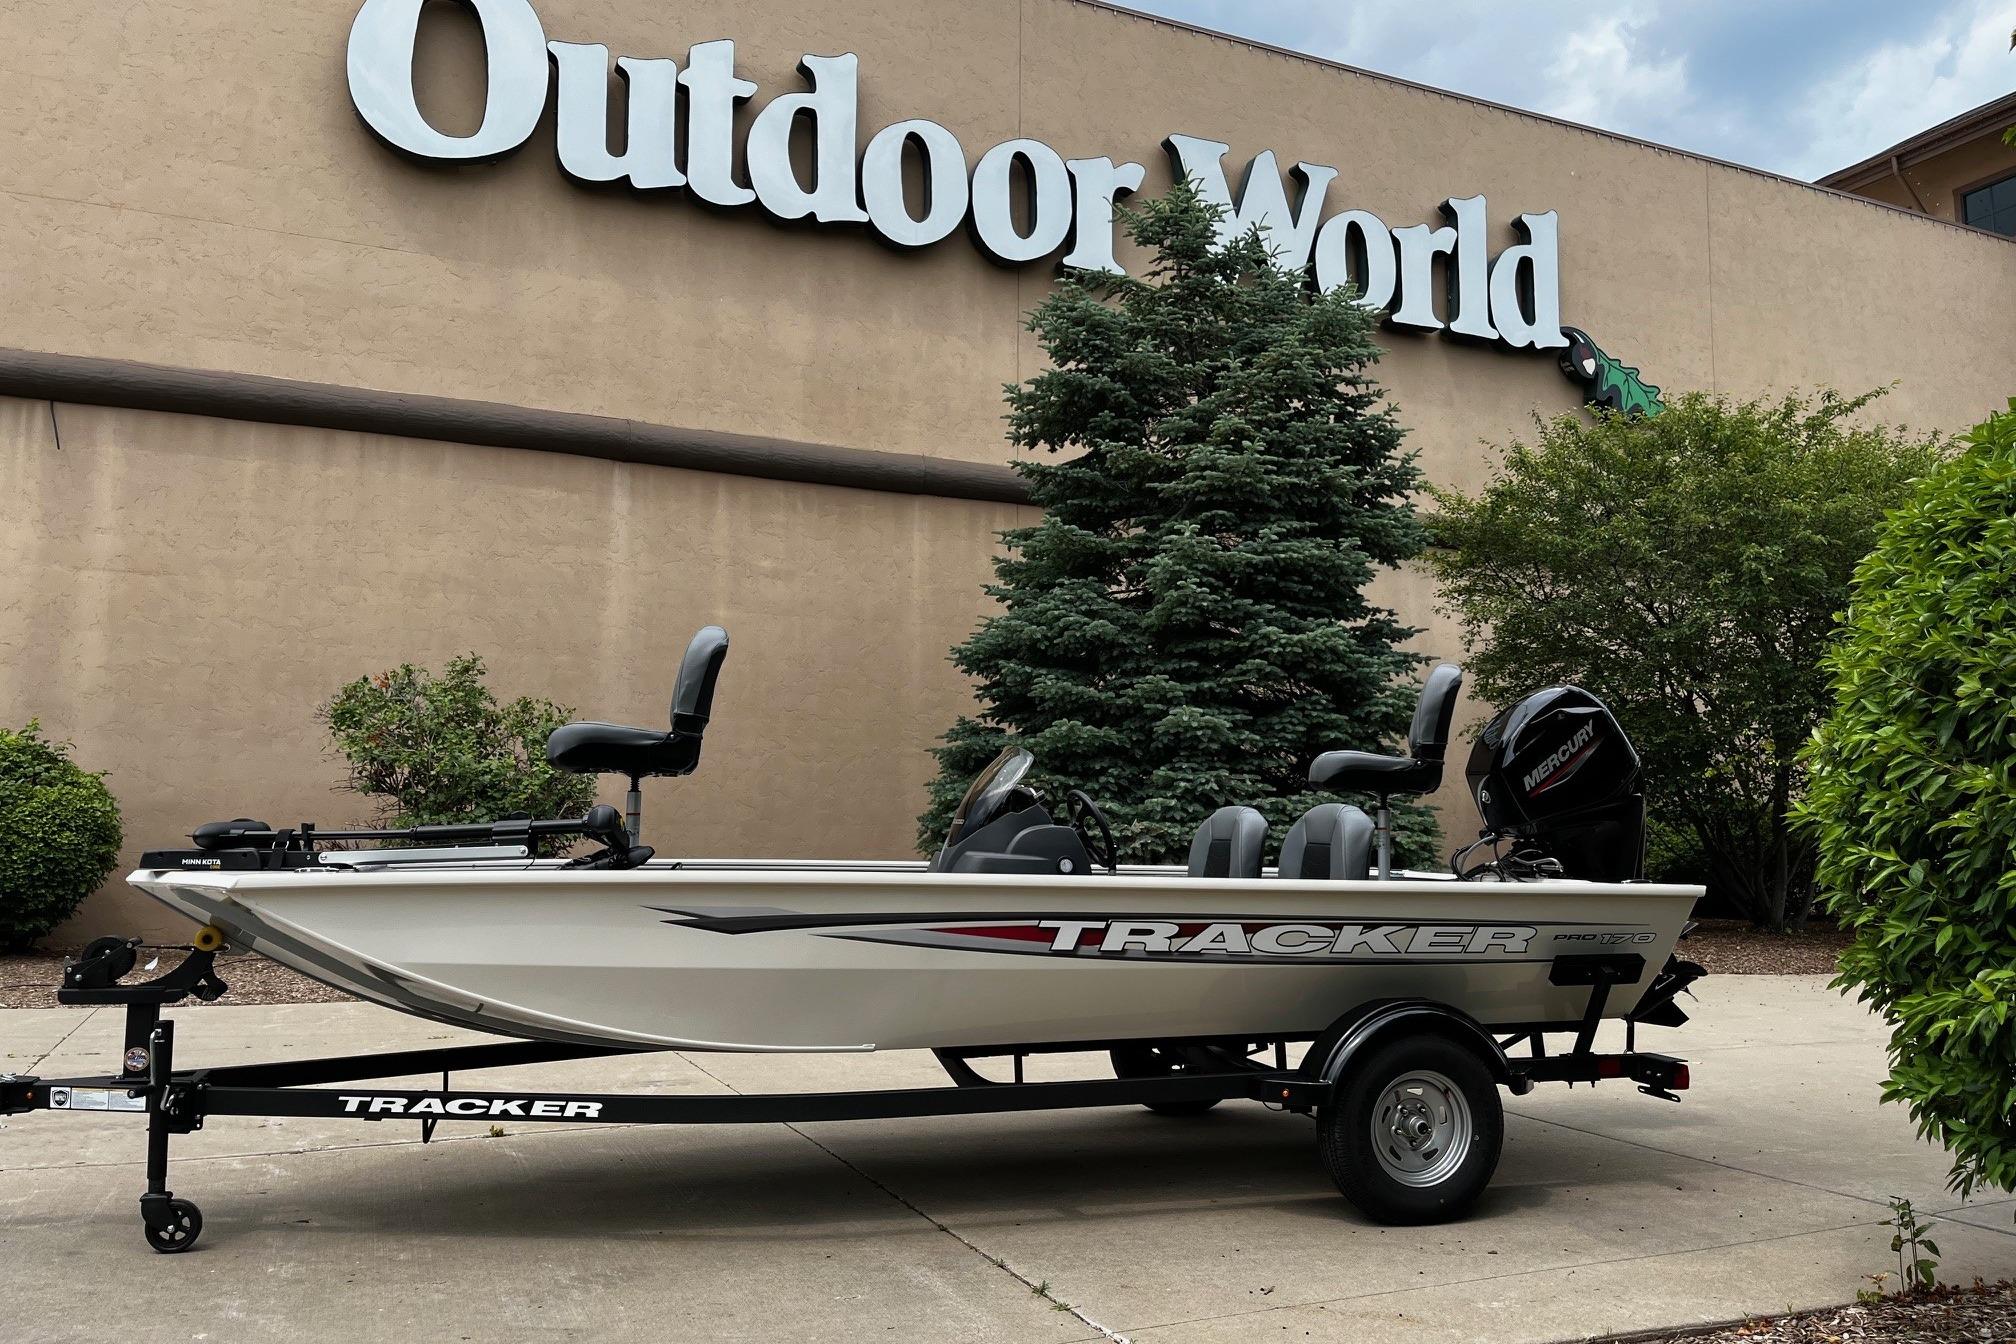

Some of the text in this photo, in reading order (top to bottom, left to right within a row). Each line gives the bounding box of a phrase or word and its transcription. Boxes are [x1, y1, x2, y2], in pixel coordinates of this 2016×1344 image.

[345, 0, 1570, 350] Outdoor World
[1523, 719, 1595, 791] MERCURY
[1037, 918, 1538, 955] TRACKER
[1552, 932, 1658, 946] PRO 170
[338, 1095, 604, 1119] TRACKER
